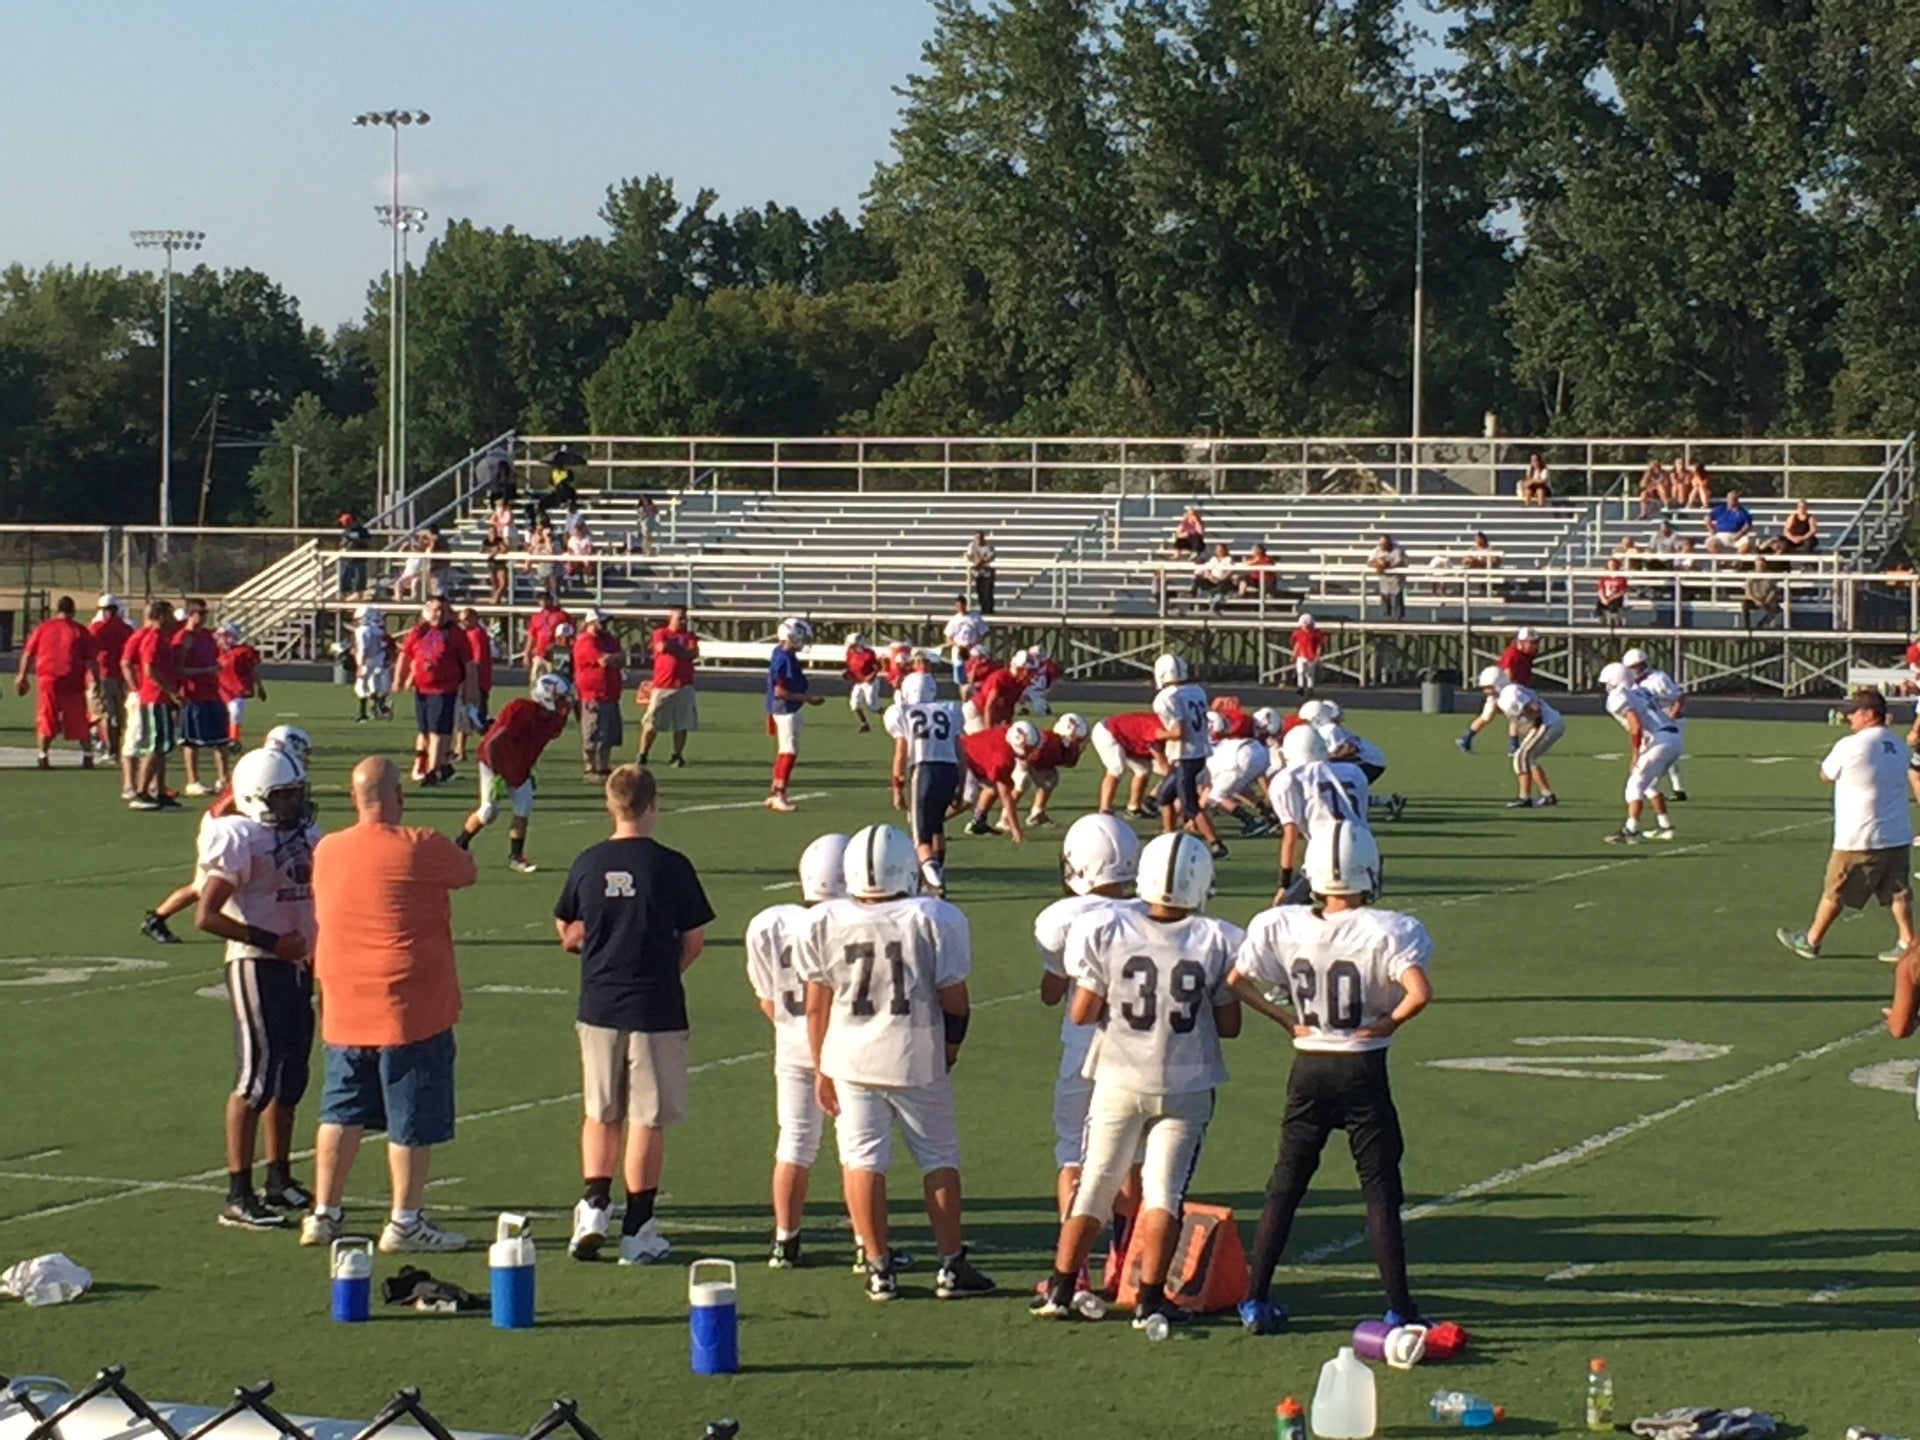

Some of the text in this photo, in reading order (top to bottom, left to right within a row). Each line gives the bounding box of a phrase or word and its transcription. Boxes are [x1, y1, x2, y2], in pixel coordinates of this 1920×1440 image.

[910, 709, 950, 740] 29
[604, 871, 636, 897] R
[844, 941, 910, 1015] 71
[1122, 955, 1205, 1034] 39
[1291, 956, 1362, 1030] 20
